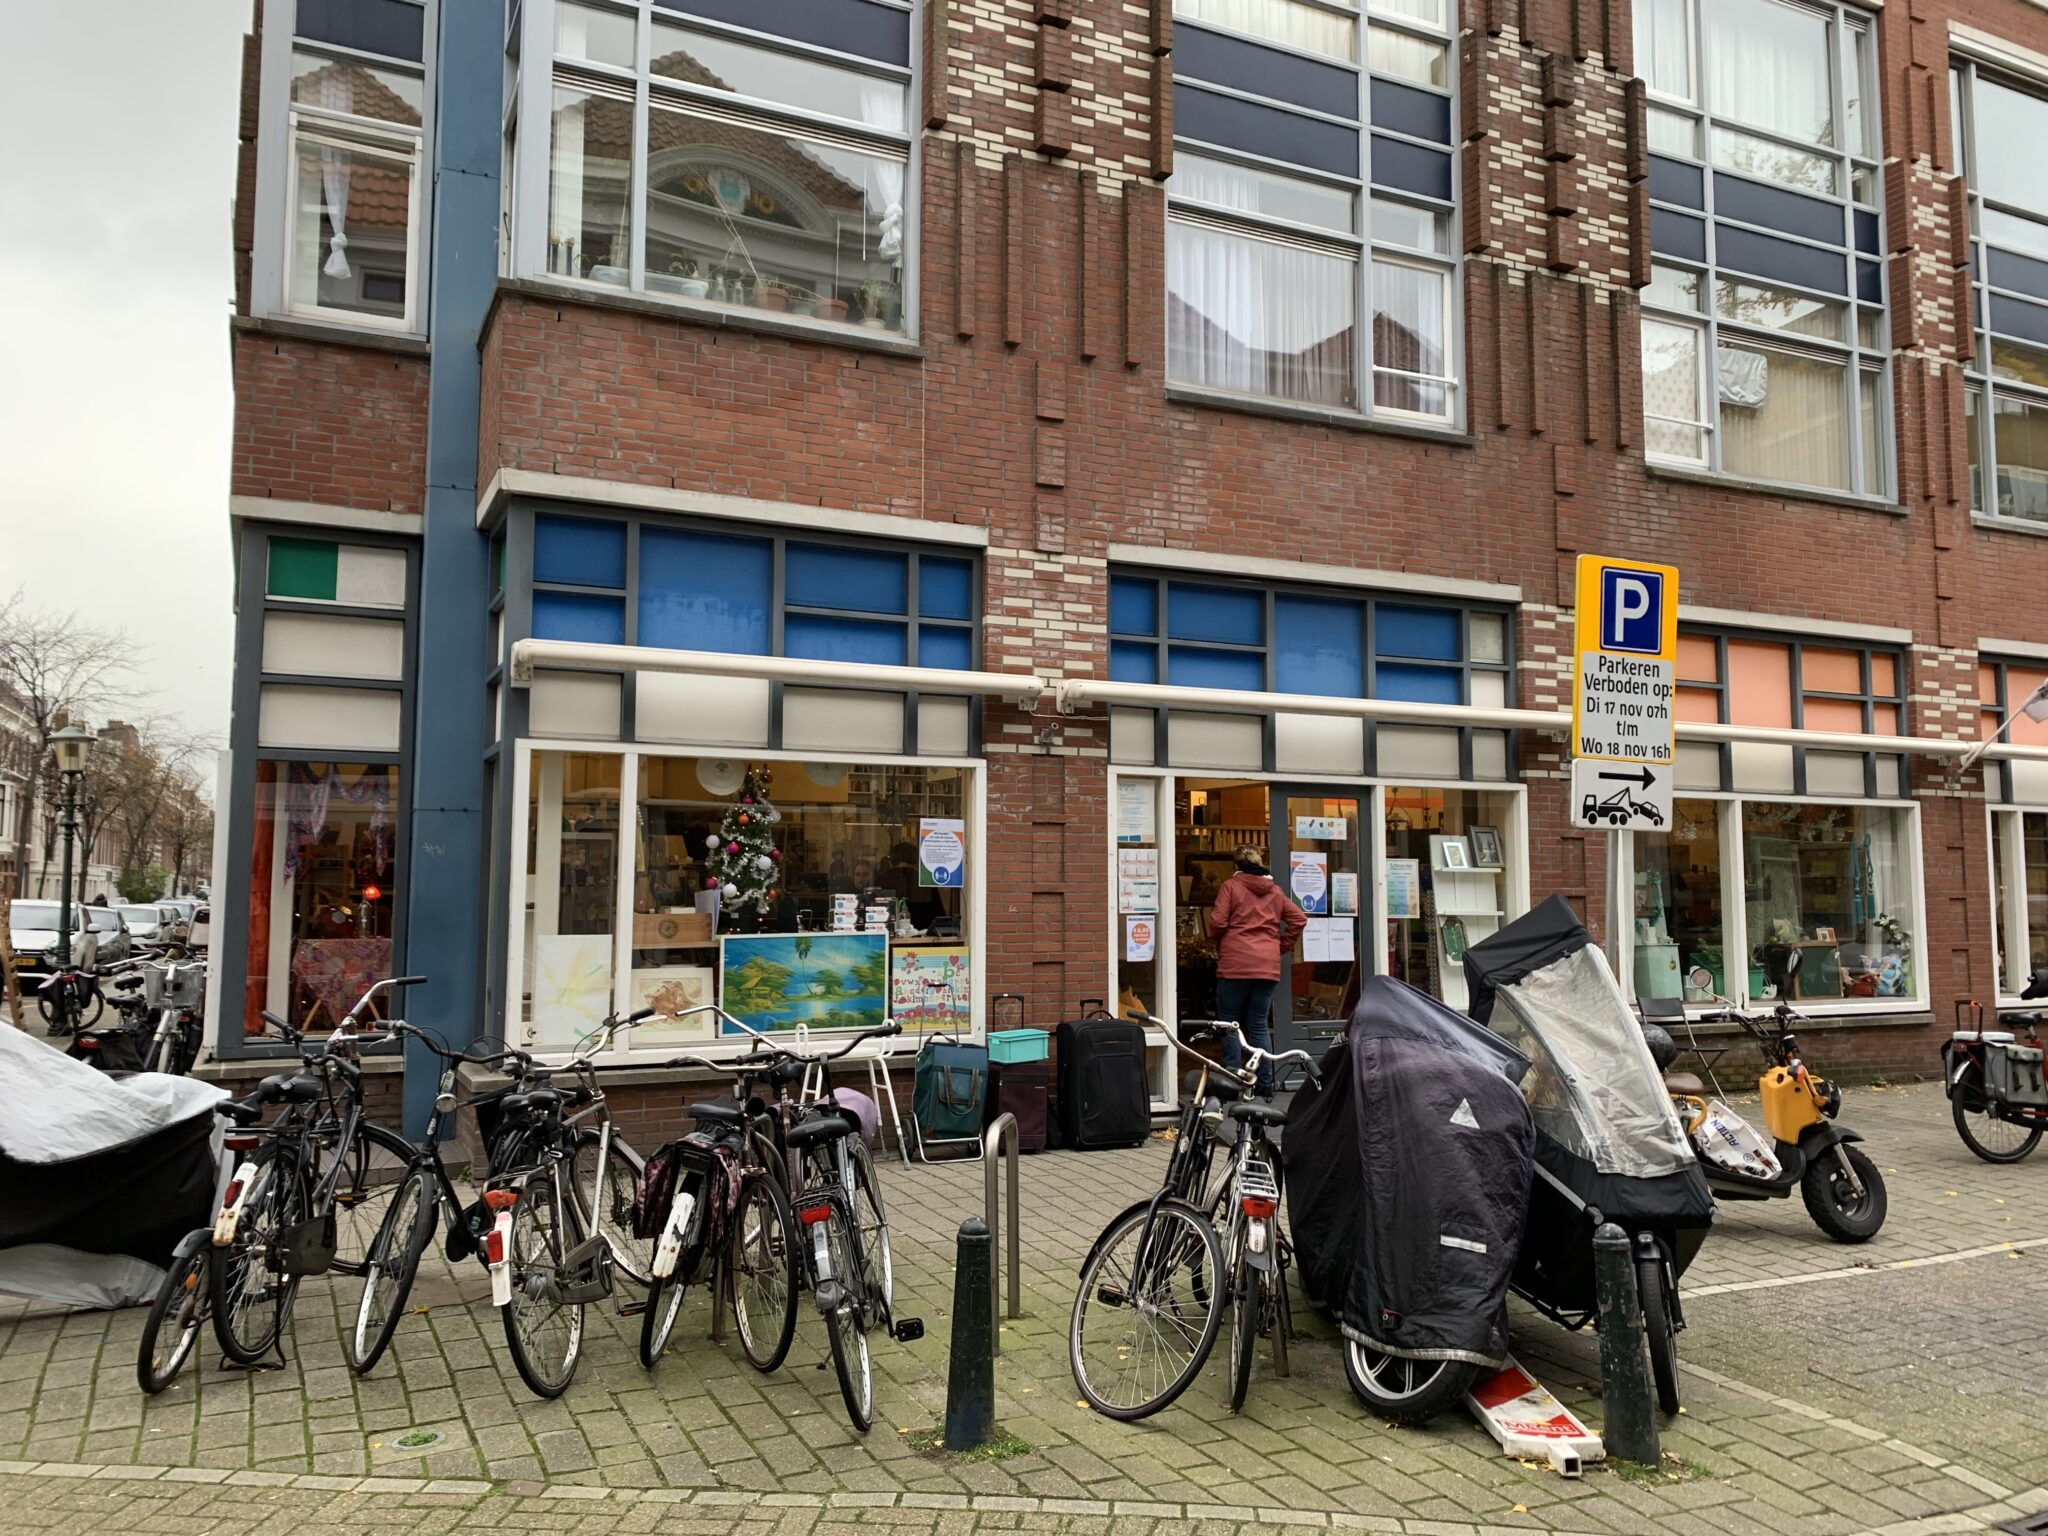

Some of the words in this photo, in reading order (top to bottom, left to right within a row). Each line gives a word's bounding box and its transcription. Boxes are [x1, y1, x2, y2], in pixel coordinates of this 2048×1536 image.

[1615, 577, 1650, 642] P
[1598, 655, 1660, 678] Parkeren
[1584, 672, 1648, 695] Verboden
[1653, 683, 1673, 701] op:
[1586, 696, 1600, 713] Di
[1604, 701, 1615, 714] 17
[1620, 703, 1643, 717] nov
[1646, 703, 1667, 719] 07h
[1616, 720, 1638, 736] t/m
[1581, 737, 1602, 754] Wo
[1607, 742, 1620, 755] 18
[1624, 743, 1647, 757] nov
[1651, 743, 1671, 759] 16h
[1710, 1119, 1740, 1148] ACTION
